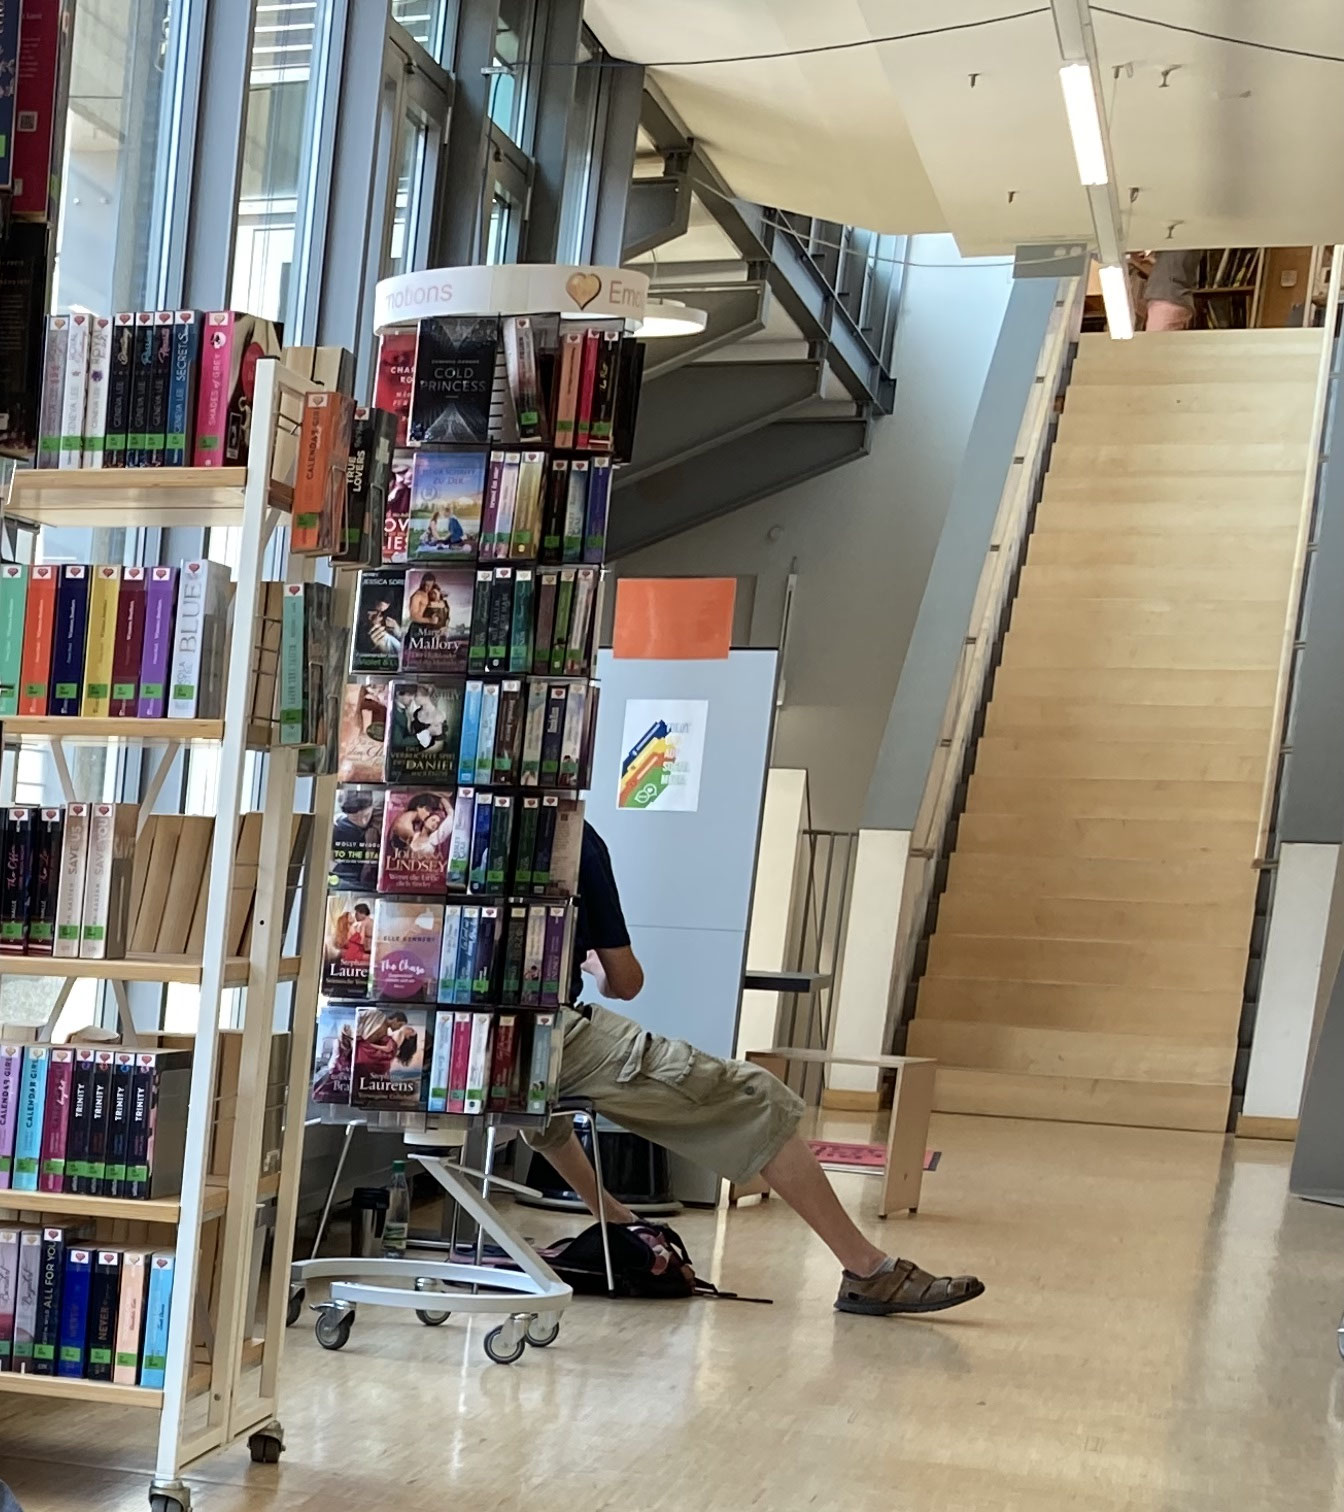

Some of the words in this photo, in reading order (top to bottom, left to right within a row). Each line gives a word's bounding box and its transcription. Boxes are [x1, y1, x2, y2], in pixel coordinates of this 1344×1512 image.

[175, 322, 190, 382] SECRETS
[420, 380, 488, 393] PRINCESS
[433, 367, 475, 380] COLD
[352, 449, 366, 493] LOVERS
[179, 582, 203, 653] BLUE
[409, 636, 462, 653] Mallory
[68, 846, 79, 875] SAVE
[334, 850, 346, 858] TO
[348, 850, 363, 859] THE
[385, 856, 448, 873] LINDSEY
[380, 960, 397, 972] The
[359, 1077, 415, 1092] Laurens
[0, 1076, 12, 1126] CALENDAR
[25, 1081, 38, 1129] CALENDAR
[75, 1083, 86, 1118] TRINITY
[93, 1084, 105, 1119] TRINITY
[114, 1086, 126, 1122] TRINITY
[134, 1087, 146, 1122] TRINITY
[44, 1263, 56, 1286] FOR
[43, 1288, 54, 1309] ALL
